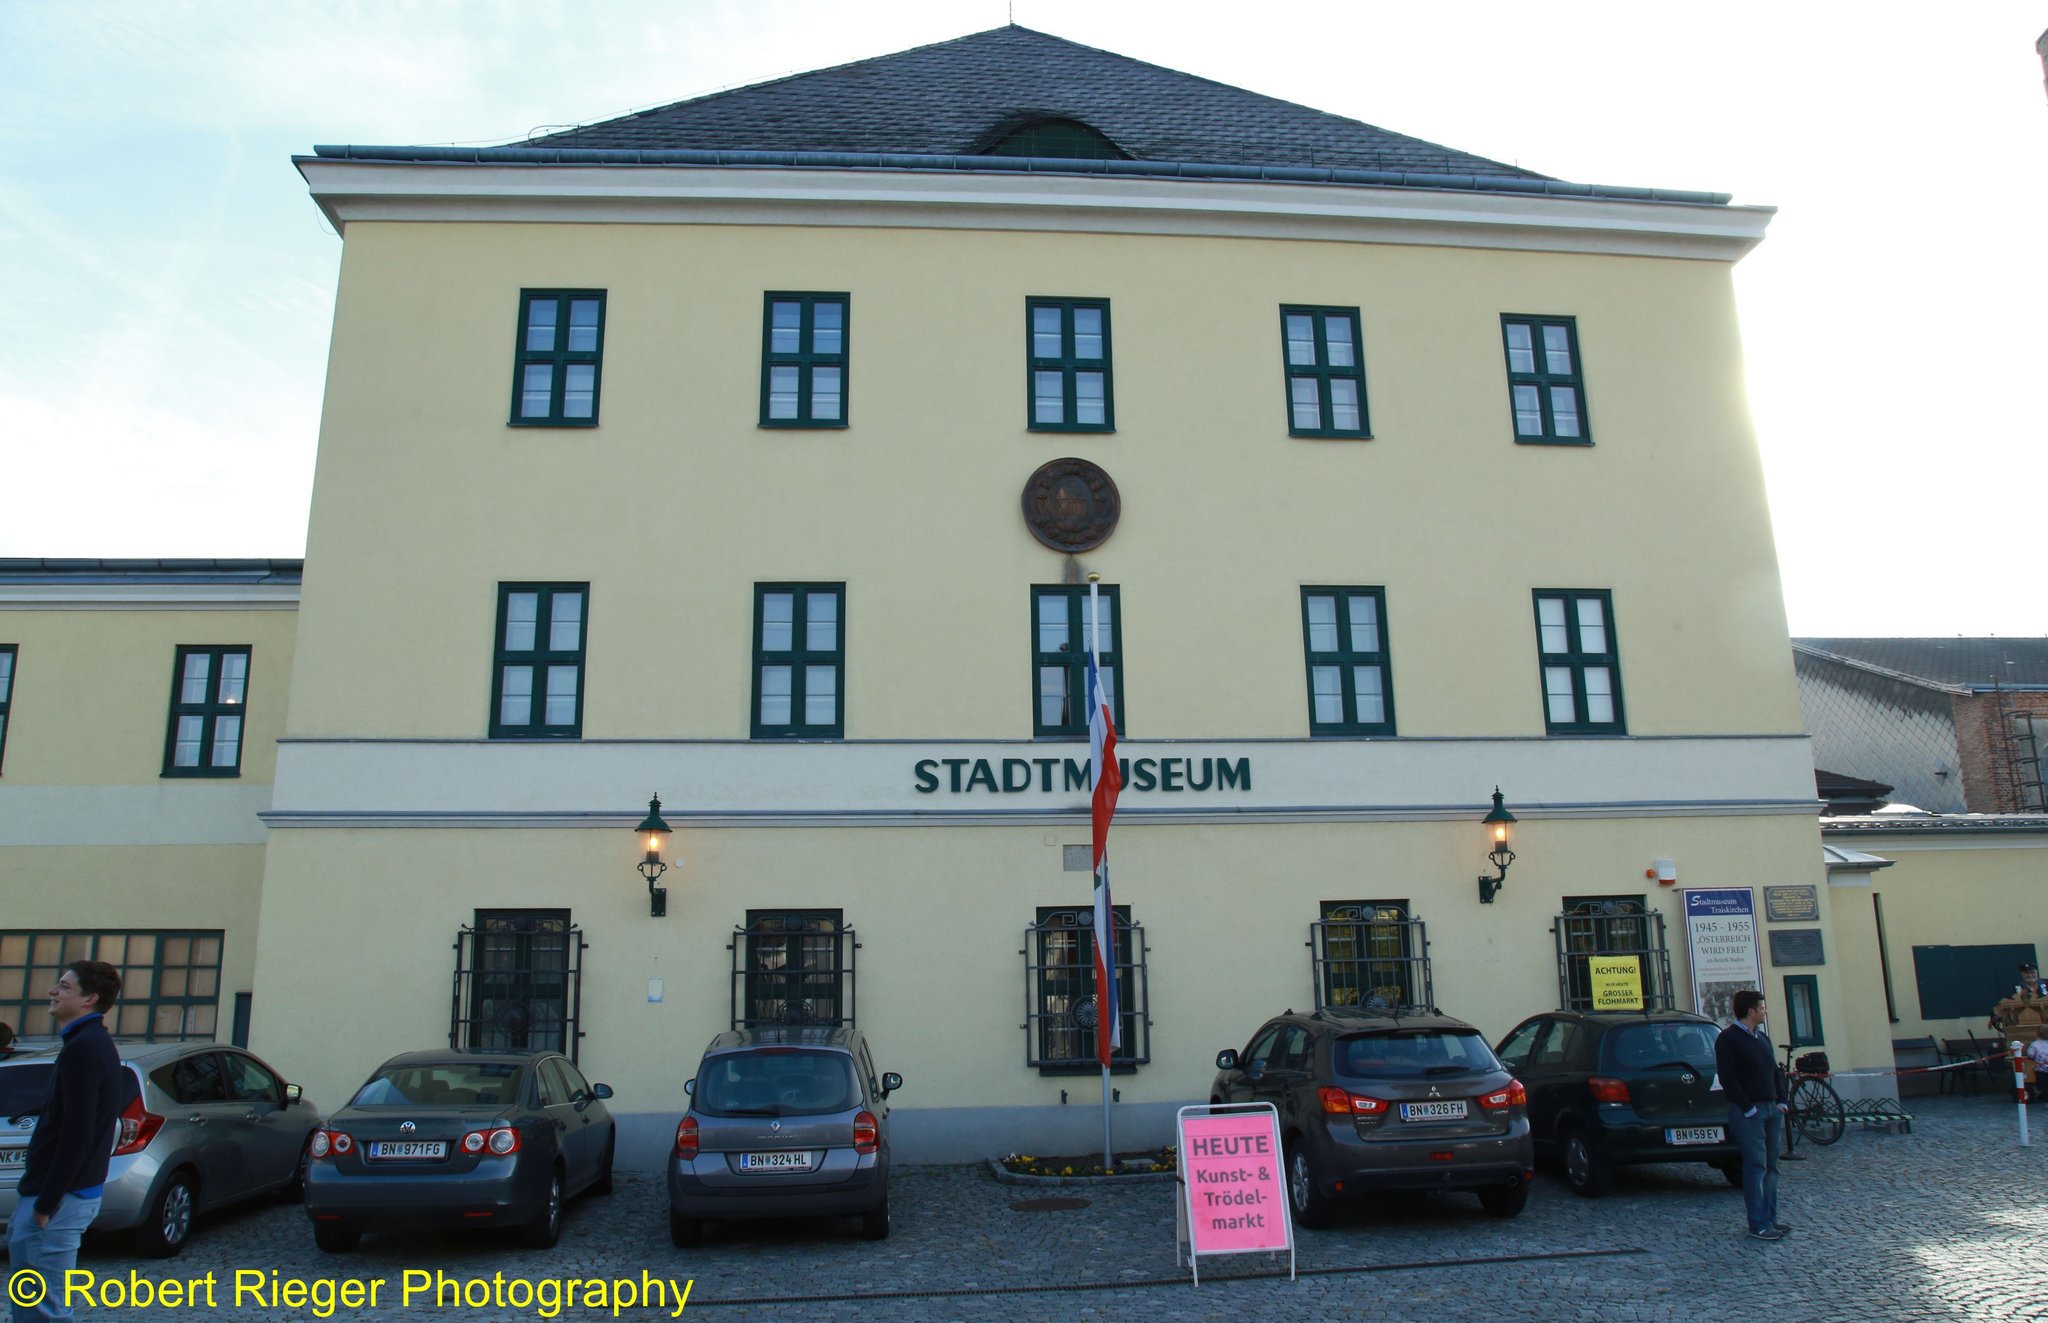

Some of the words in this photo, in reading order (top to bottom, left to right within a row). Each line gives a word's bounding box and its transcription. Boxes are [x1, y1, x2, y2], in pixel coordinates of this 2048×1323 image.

[1691, 895, 1737, 906] Stadtmuseum
[1711, 906, 1749, 914] Traiskirchen
[1695, 922, 1718, 932] 1945
[1727, 921, 1750, 931] 1955
[1701, 946, 1725, 955] WIRD
[1410, 1105, 1423, 1116] BN
[1430, 1103, 1449, 1115] 326
[1451, 1102, 1464, 1113] FH
[1675, 1130, 1688, 1141] BN
[1694, 1129, 1706, 1139] 59
[1707, 1128, 1718, 1139] EV
[381, 1143, 397, 1155] BN
[1193, 1135, 1269, 1156] HEUTE
[750, 1155, 764, 1167] BN
[772, 1154, 792, 1166] 324
[794, 1153, 807, 1165] HL
[1197, 1167, 1253, 1184] Kunst-
[1258, 1166, 1271, 1181] &
[1203, 1189, 1267, 1207] Trödel-
[1212, 1213, 1265, 1230] markt
